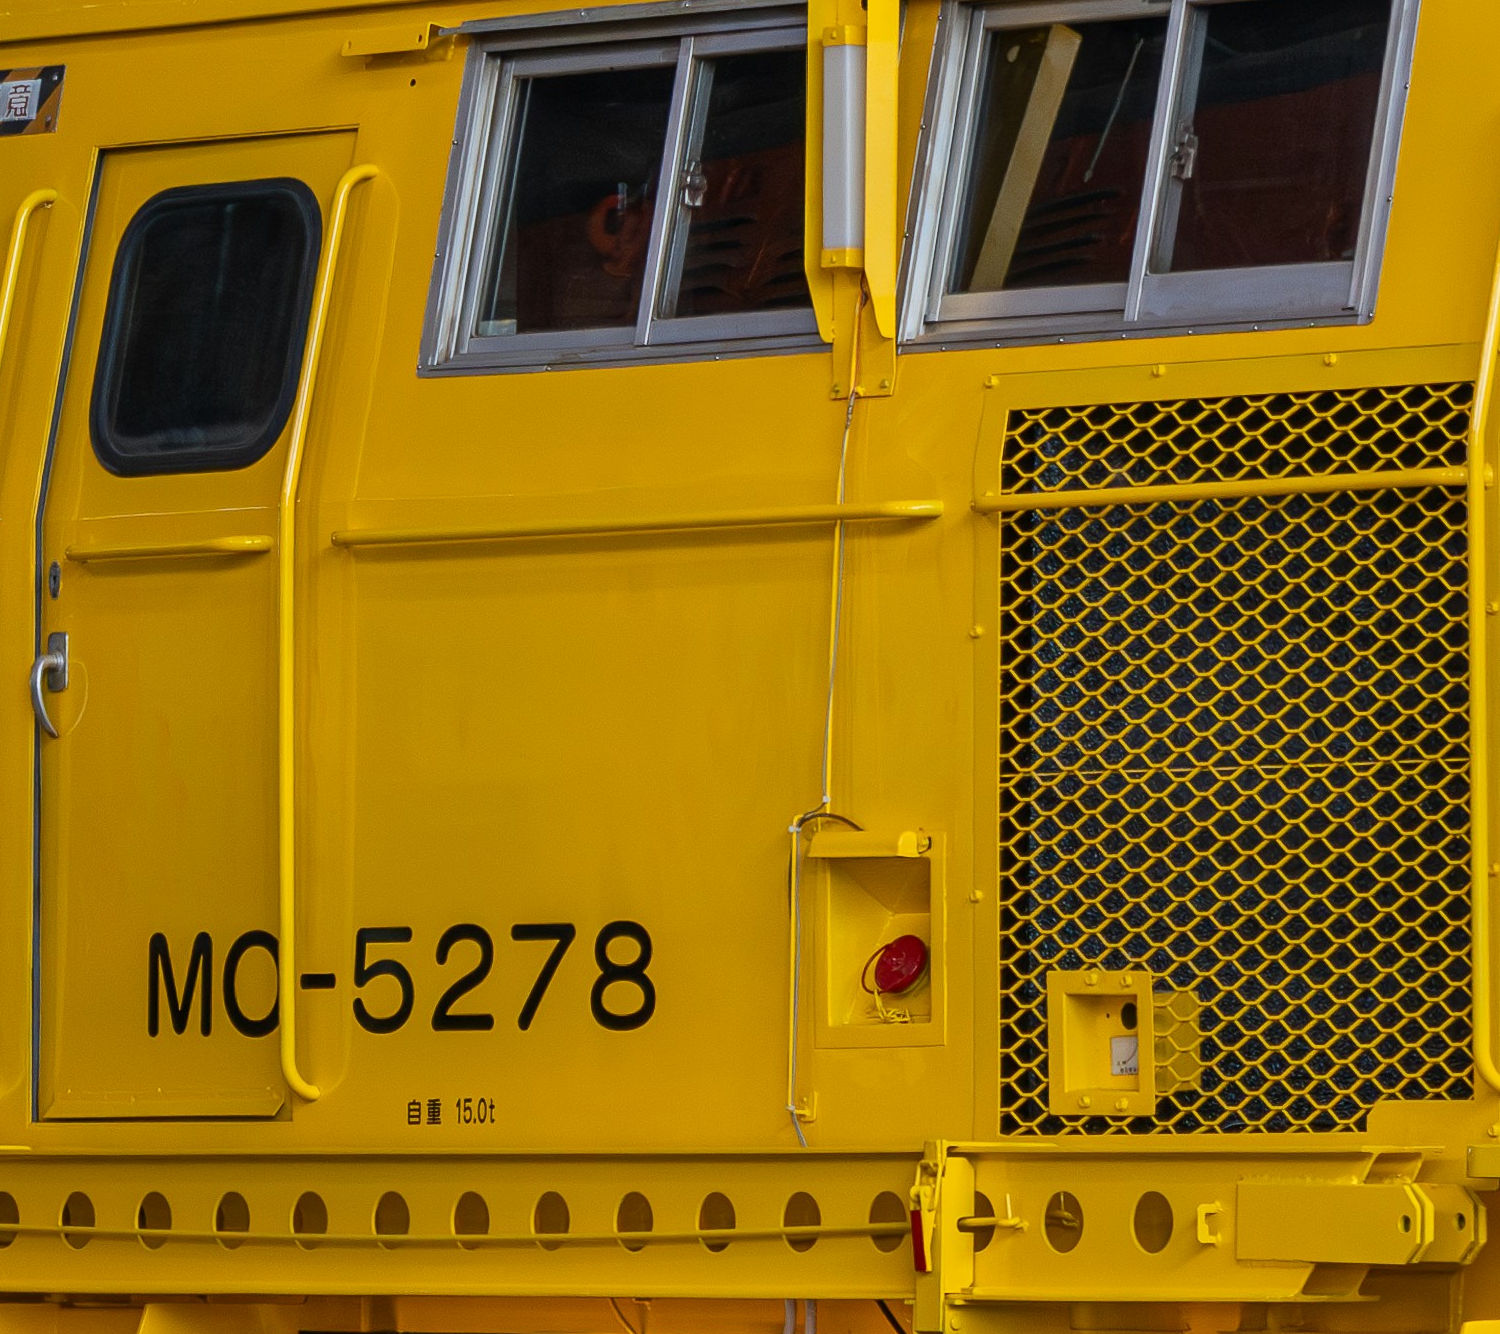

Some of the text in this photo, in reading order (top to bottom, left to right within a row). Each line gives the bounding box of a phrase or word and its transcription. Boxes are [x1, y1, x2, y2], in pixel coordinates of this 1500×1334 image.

[147, 920, 657, 1038] MO-5278
[407, 1097, 495, 1125] 自重 15.0t
